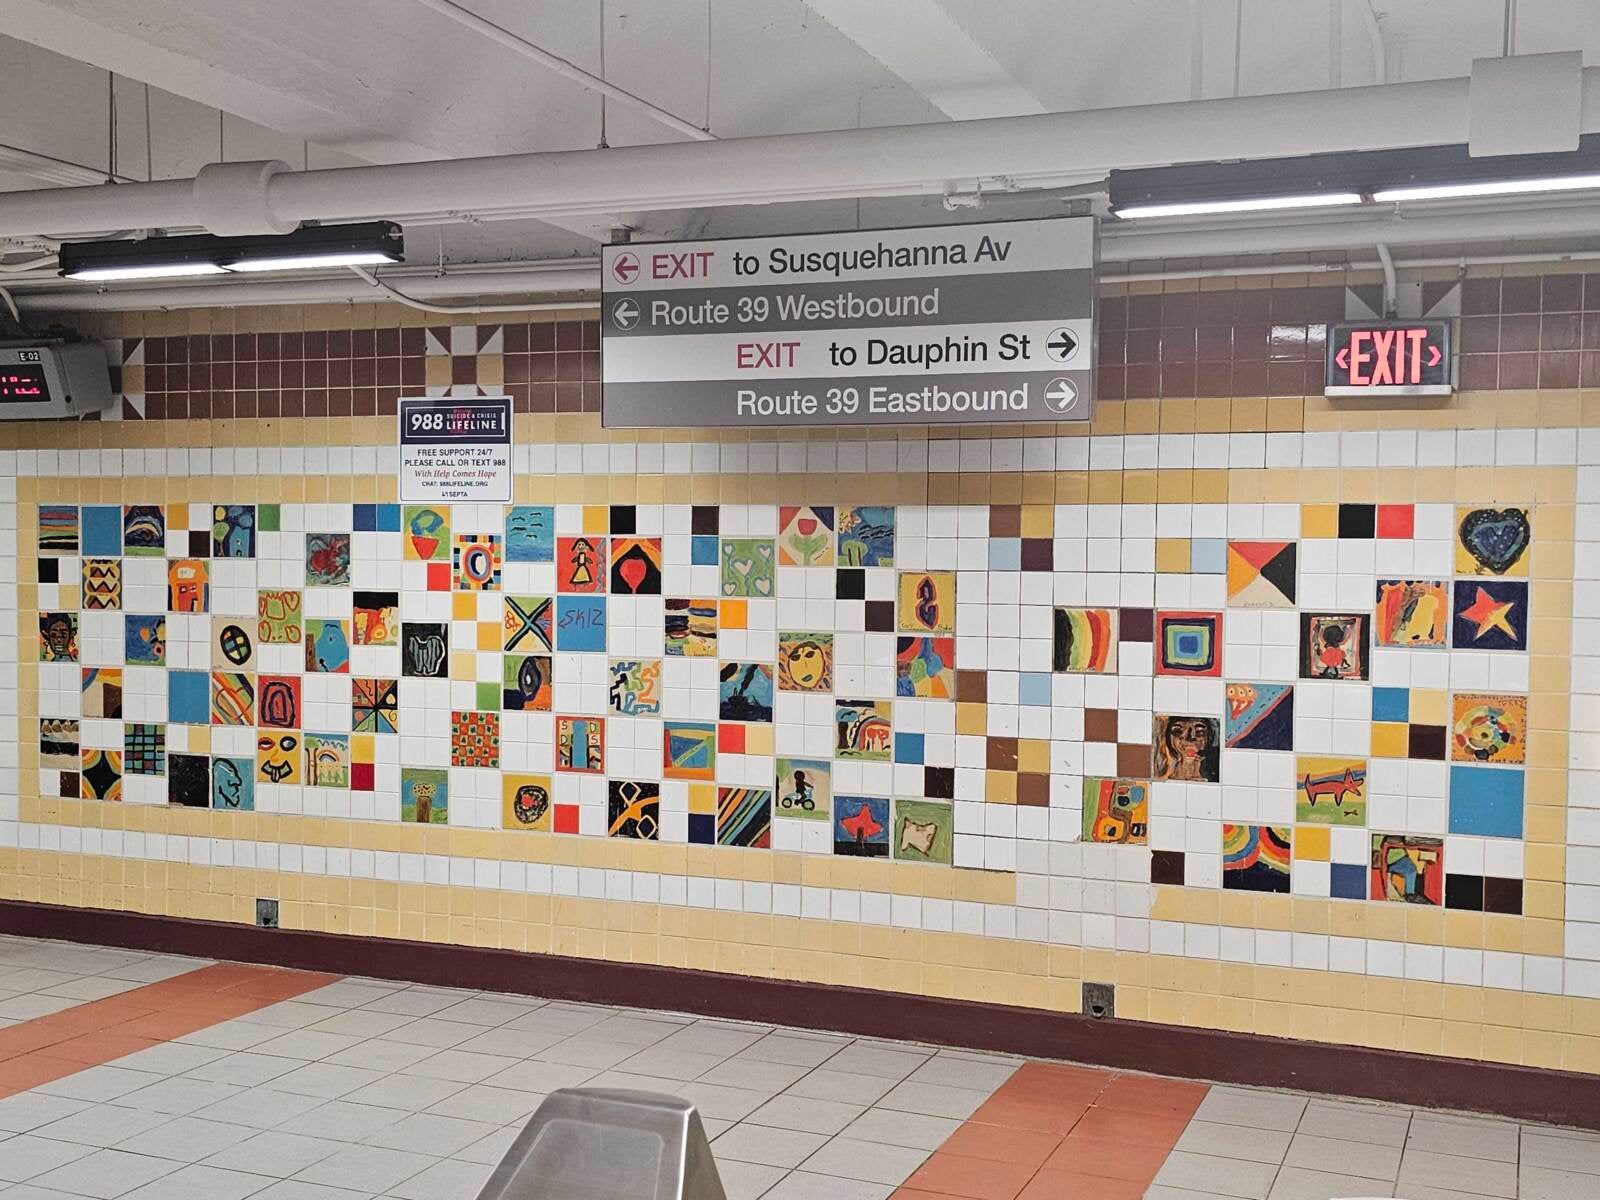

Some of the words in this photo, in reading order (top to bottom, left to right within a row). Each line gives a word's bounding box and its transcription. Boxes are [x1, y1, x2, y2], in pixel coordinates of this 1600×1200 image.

[651, 251, 714, 279] EXIT
[733, 252, 760, 276] to
[769, 241, 967, 277] Susquehanna
[975, 236, 1011, 263] Av
[651, 300, 729, 326] Route
[737, 297, 769, 323] 39
[777, 288, 940, 321] Westbound
[20, 352, 39, 361] E-02
[736, 342, 800, 369] EXIT
[829, 343, 857, 366] to
[867, 336, 988, 369] Dauphin
[998, 334, 1031, 361] St
[1350, 329, 1427, 385] EXIT
[737, 390, 817, 416] Route
[826, 388, 859, 414] 39
[869, 382, 1029, 414] Eastbound
[411, 413, 443, 431] 988
[446, 420, 497, 430] LIFELINE
[477, 448, 493, 456] 24/7
[404, 459, 433, 467] PLEASE
[436, 459, 455, 467] CALL
[415, 470, 432, 478] With
[433, 470, 451, 479] Help
[452, 470, 476, 478] Comes
[477, 469, 497, 479] Hope
